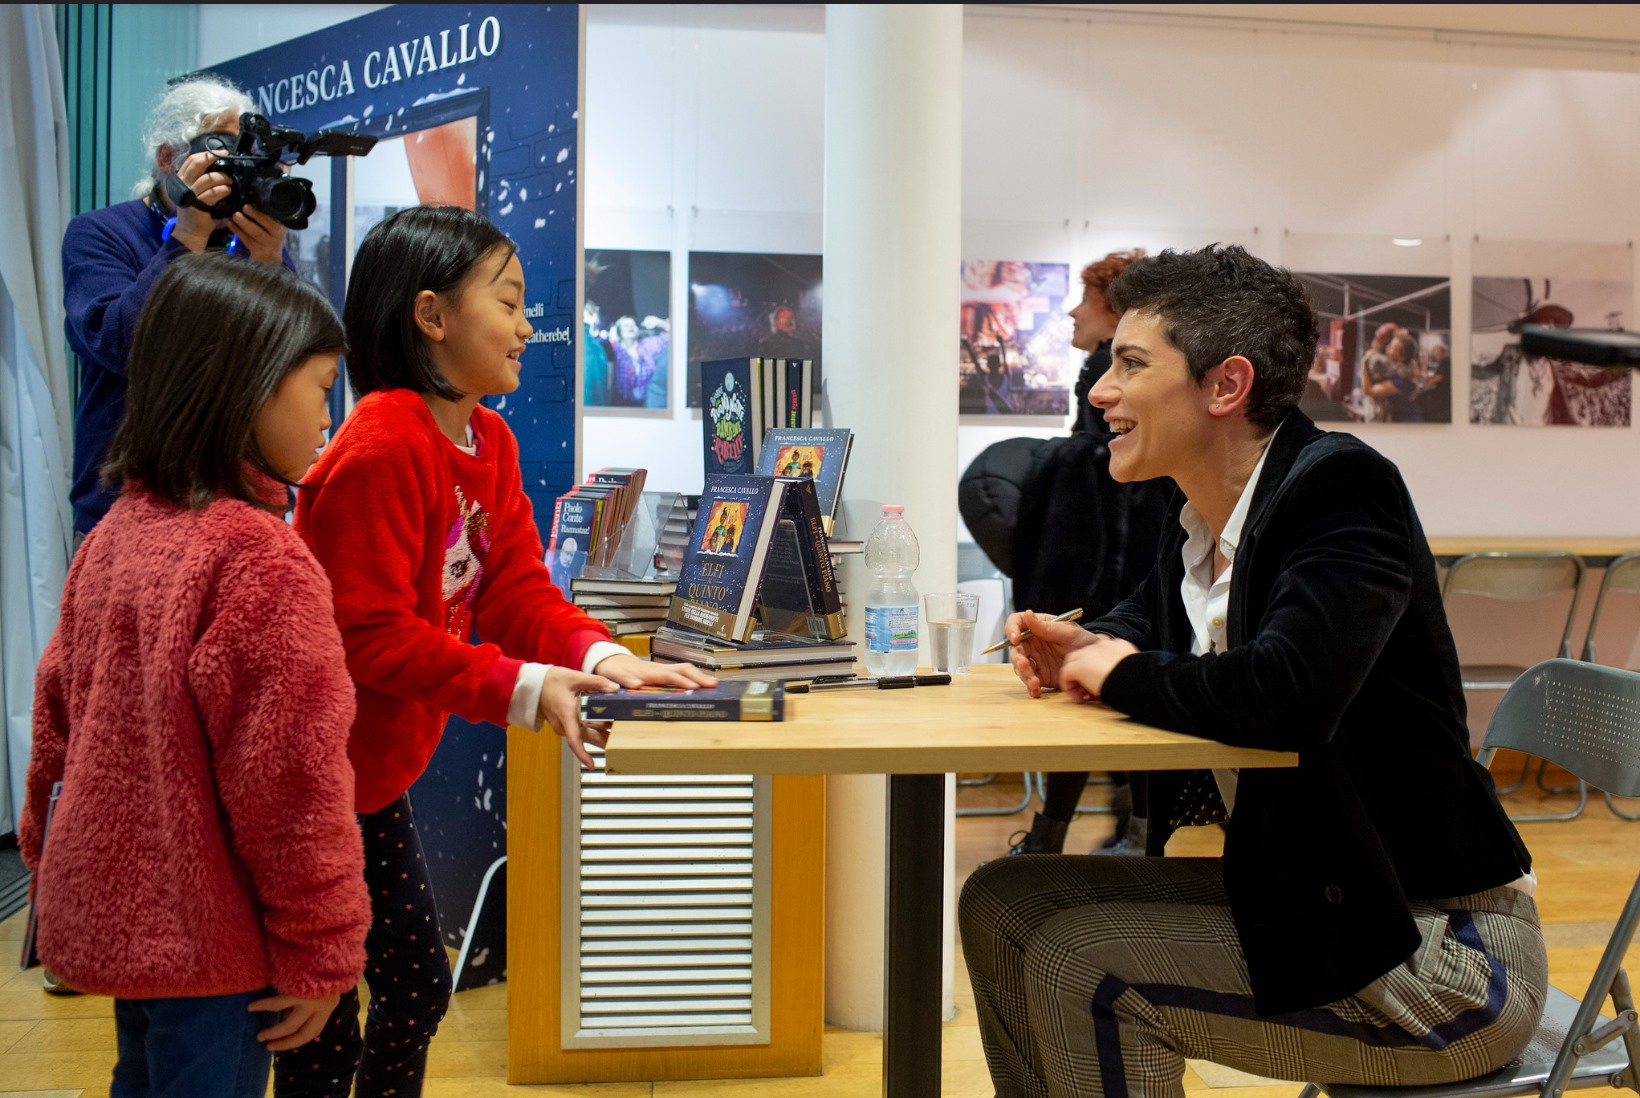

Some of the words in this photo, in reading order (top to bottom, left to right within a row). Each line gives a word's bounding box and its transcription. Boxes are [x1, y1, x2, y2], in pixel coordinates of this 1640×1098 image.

[247, 60, 356, 117] NCESCA
[363, 15, 502, 90] CAVALLO
[710, 485, 737, 494] FRANCESCA
[737, 486, 759, 495] CAVALLO
[563, 502, 583, 513] Paolo
[562, 512, 583, 523] Conte
[815, 539, 826, 569] QUINTO
[821, 568, 832, 593] PIANO
[688, 582, 726, 601] QUINTO
